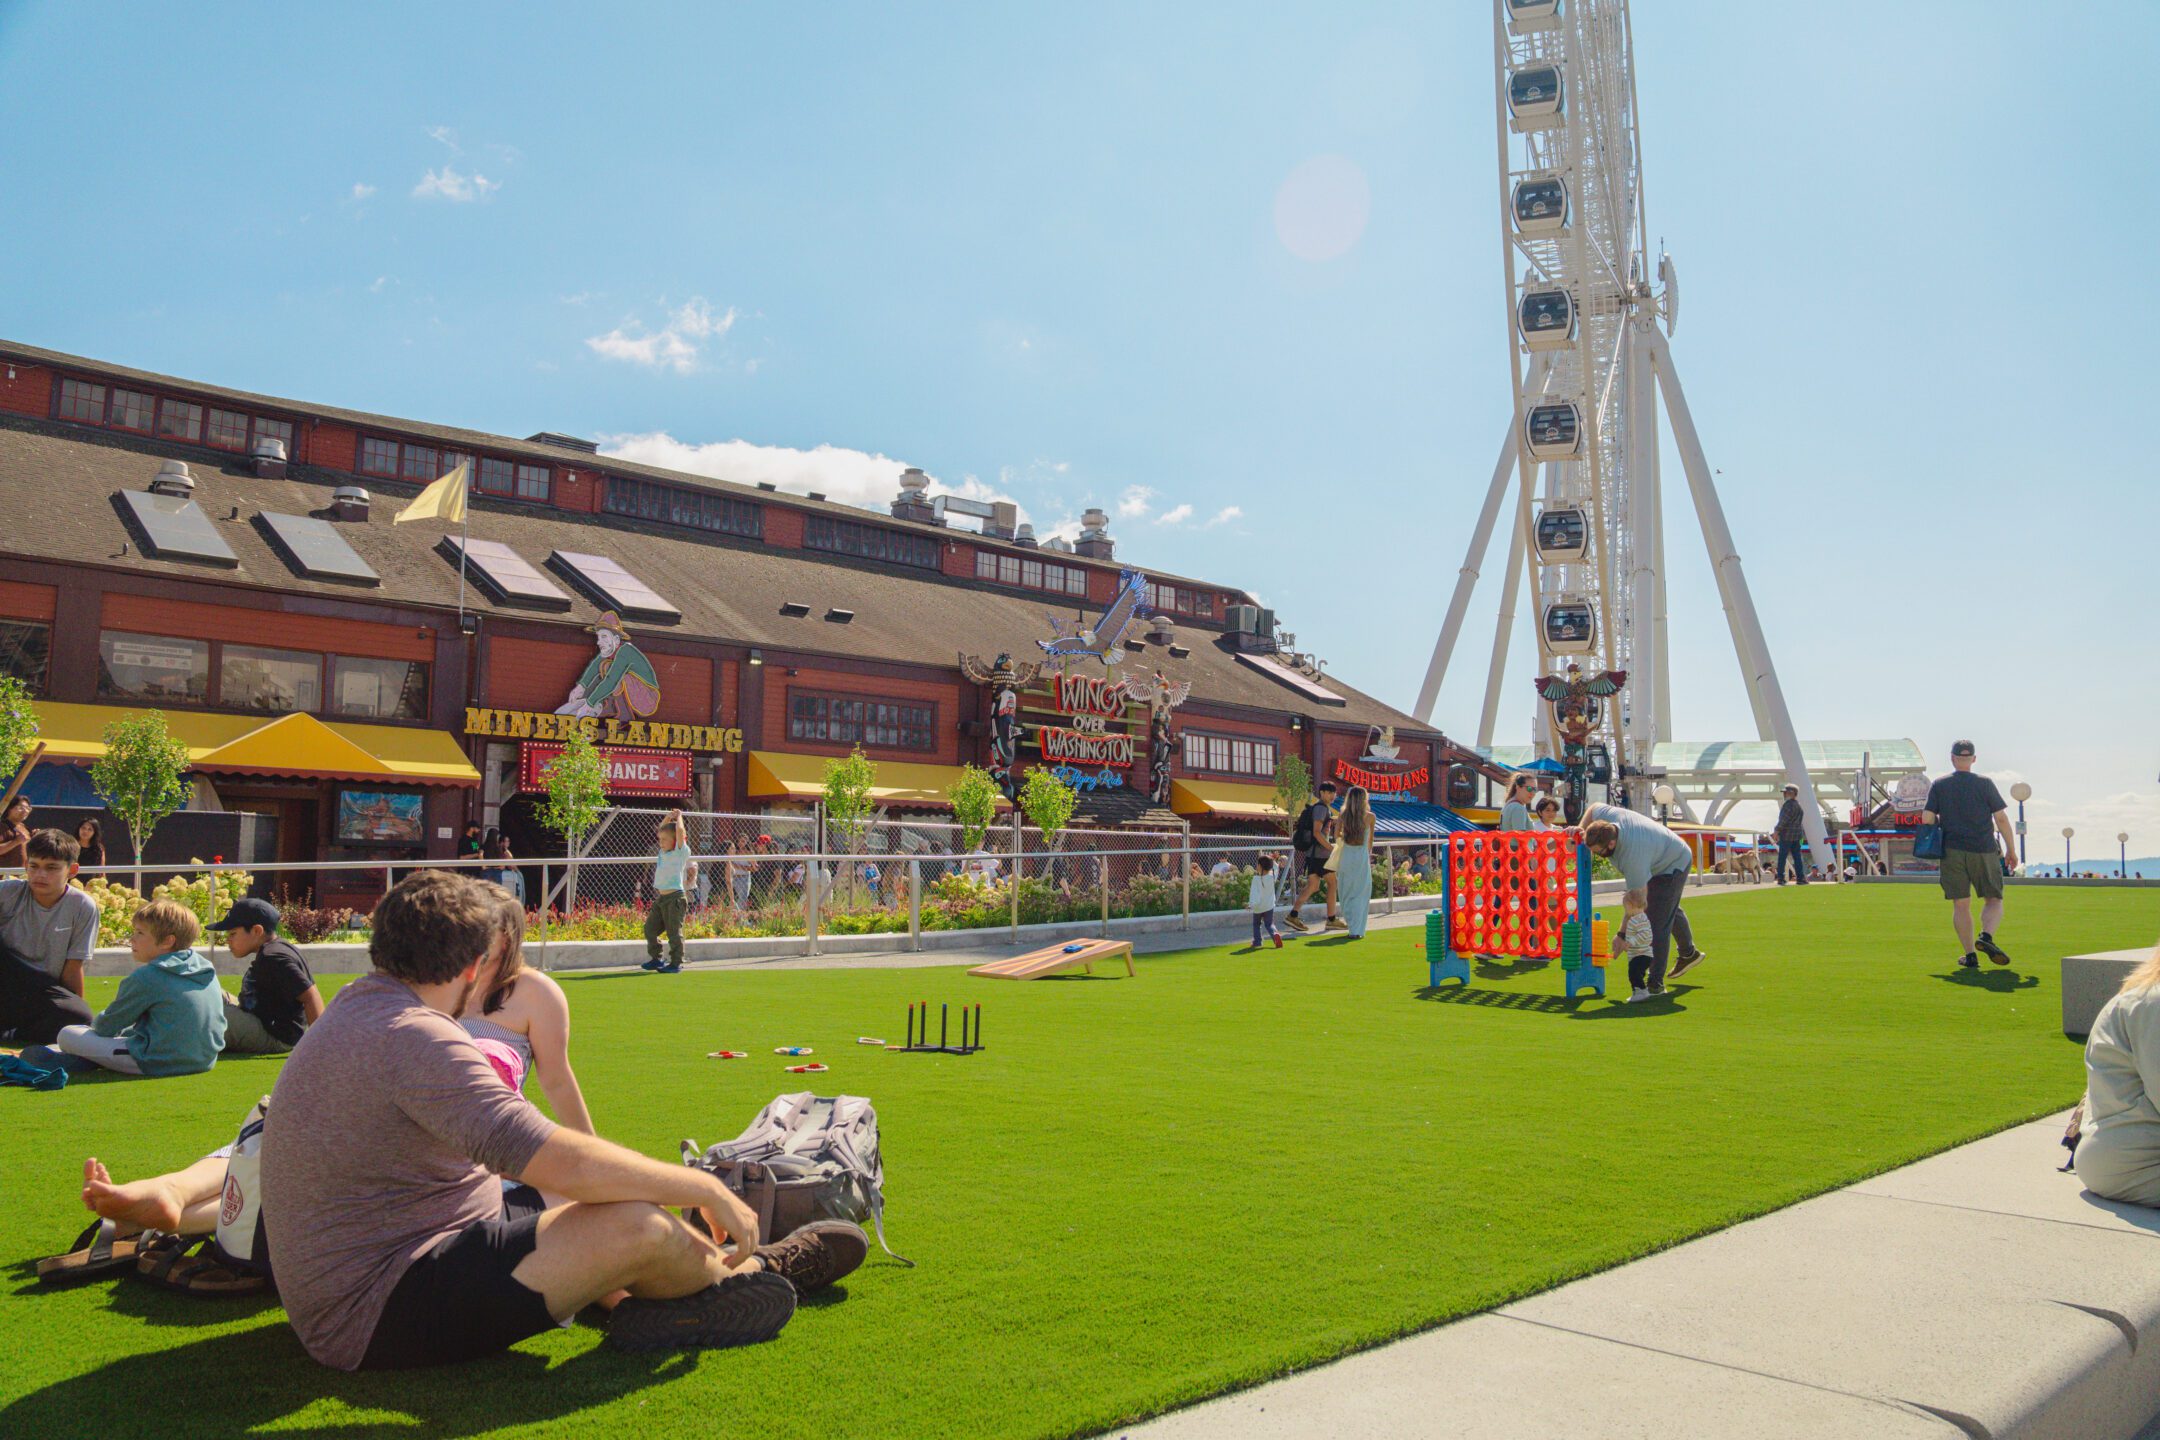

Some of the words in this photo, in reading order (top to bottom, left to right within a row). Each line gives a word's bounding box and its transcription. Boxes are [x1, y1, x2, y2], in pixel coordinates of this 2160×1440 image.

[1055, 671, 1127, 719] WINGS
[463, 706, 600, 744] MINERS
[603, 717, 744, 753] LANDING
[1072, 715, 1106, 733] OVER
[1041, 727, 1134, 766] WASHINGTON
[1061, 766, 1098, 791] Flying
[1335, 758, 1430, 792] FISHERMANS
[1892, 813, 1922, 825] TICK
